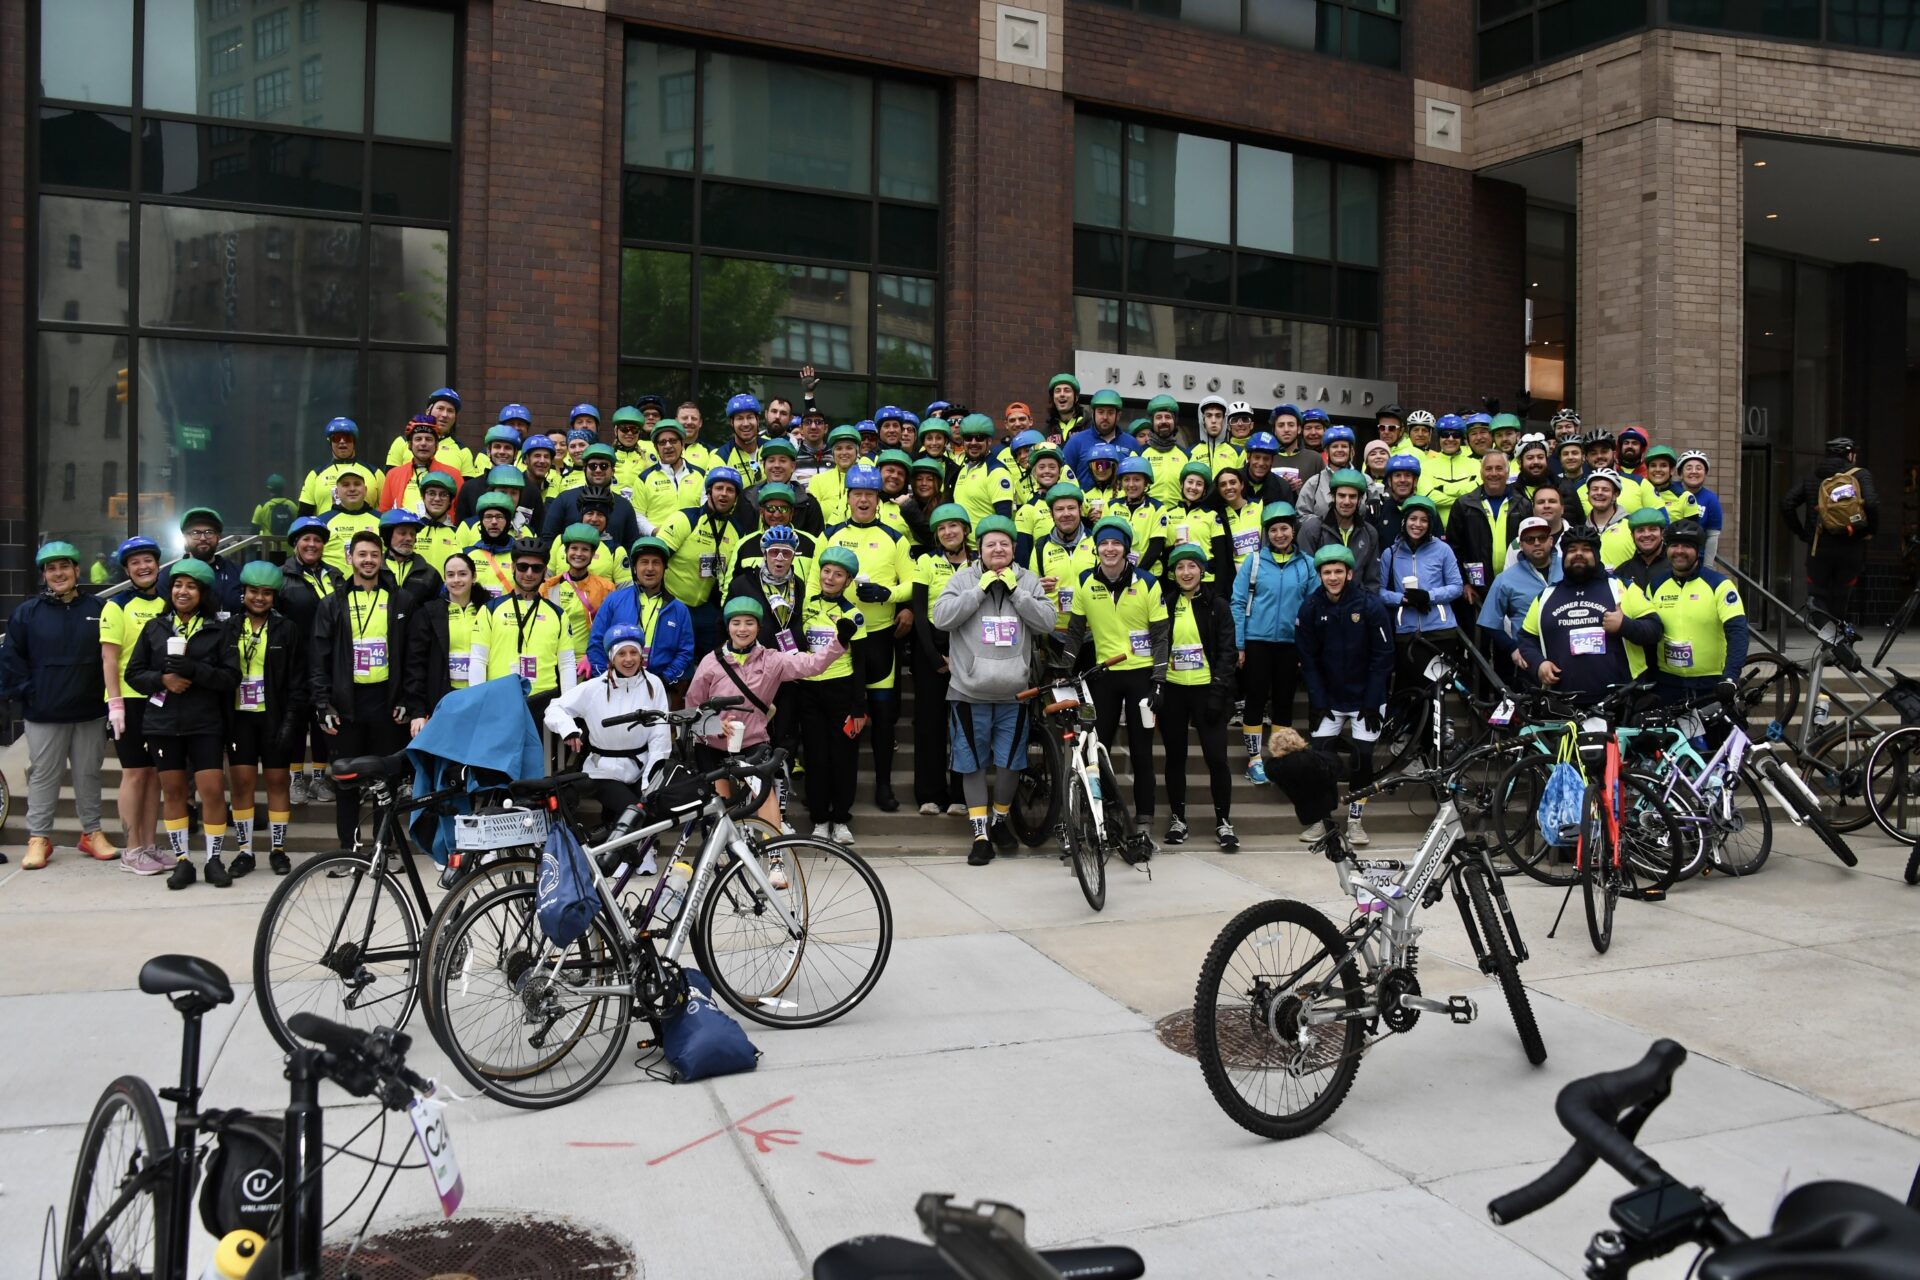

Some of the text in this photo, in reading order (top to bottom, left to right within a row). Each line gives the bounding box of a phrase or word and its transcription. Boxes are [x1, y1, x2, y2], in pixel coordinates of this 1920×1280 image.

[1105, 367, 1375, 407] HARBOR GRAND
[1234, 535, 1260, 549] C2405
[1552, 601, 1608, 617] BOOMER ESIASON
[1558, 616, 1599, 626] FOUNDATION
[807, 636, 833, 646] C2427
[1572, 636, 1604, 646] C2425
[1174, 653, 1201, 662] C2453
[1665, 649, 1691, 659] C2410
[1433, 698, 1441, 752] FELT
[273, 824, 282, 845] TEAM
[212, 836, 223, 855] TEAM
[663, 832, 700, 879] TREK
[1407, 830, 1451, 903] MONGOOSE
[677, 861, 715, 945] cannondale
